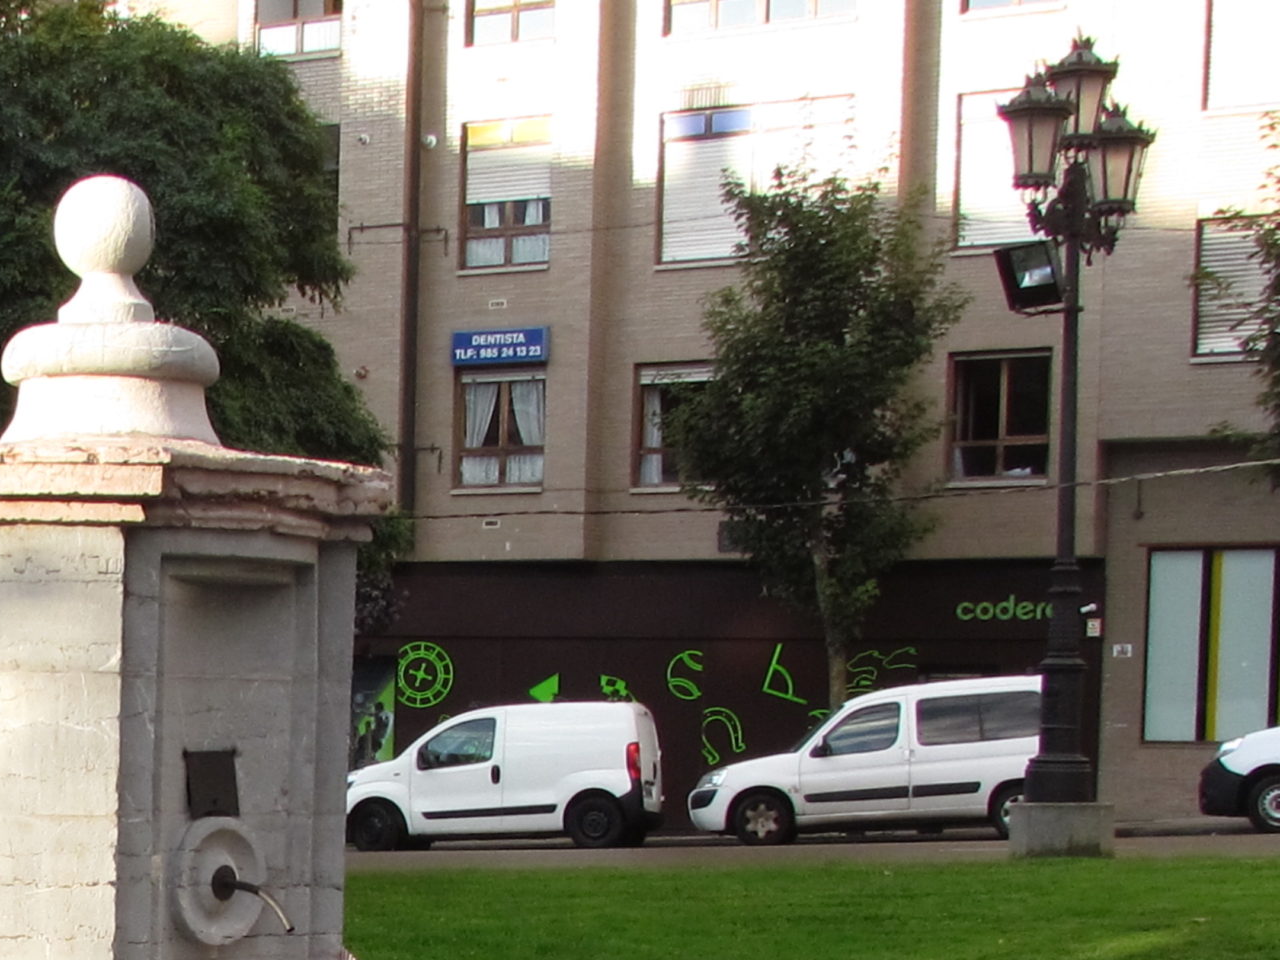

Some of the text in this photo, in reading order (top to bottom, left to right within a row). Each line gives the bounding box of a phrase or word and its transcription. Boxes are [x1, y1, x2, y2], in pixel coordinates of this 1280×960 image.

[471, 332, 526, 346] DENTISTA
[455, 348, 478, 360] TLF:
[501, 347, 515, 358] 24
[517, 346, 527, 357] 13
[528, 345, 542, 356] 23
